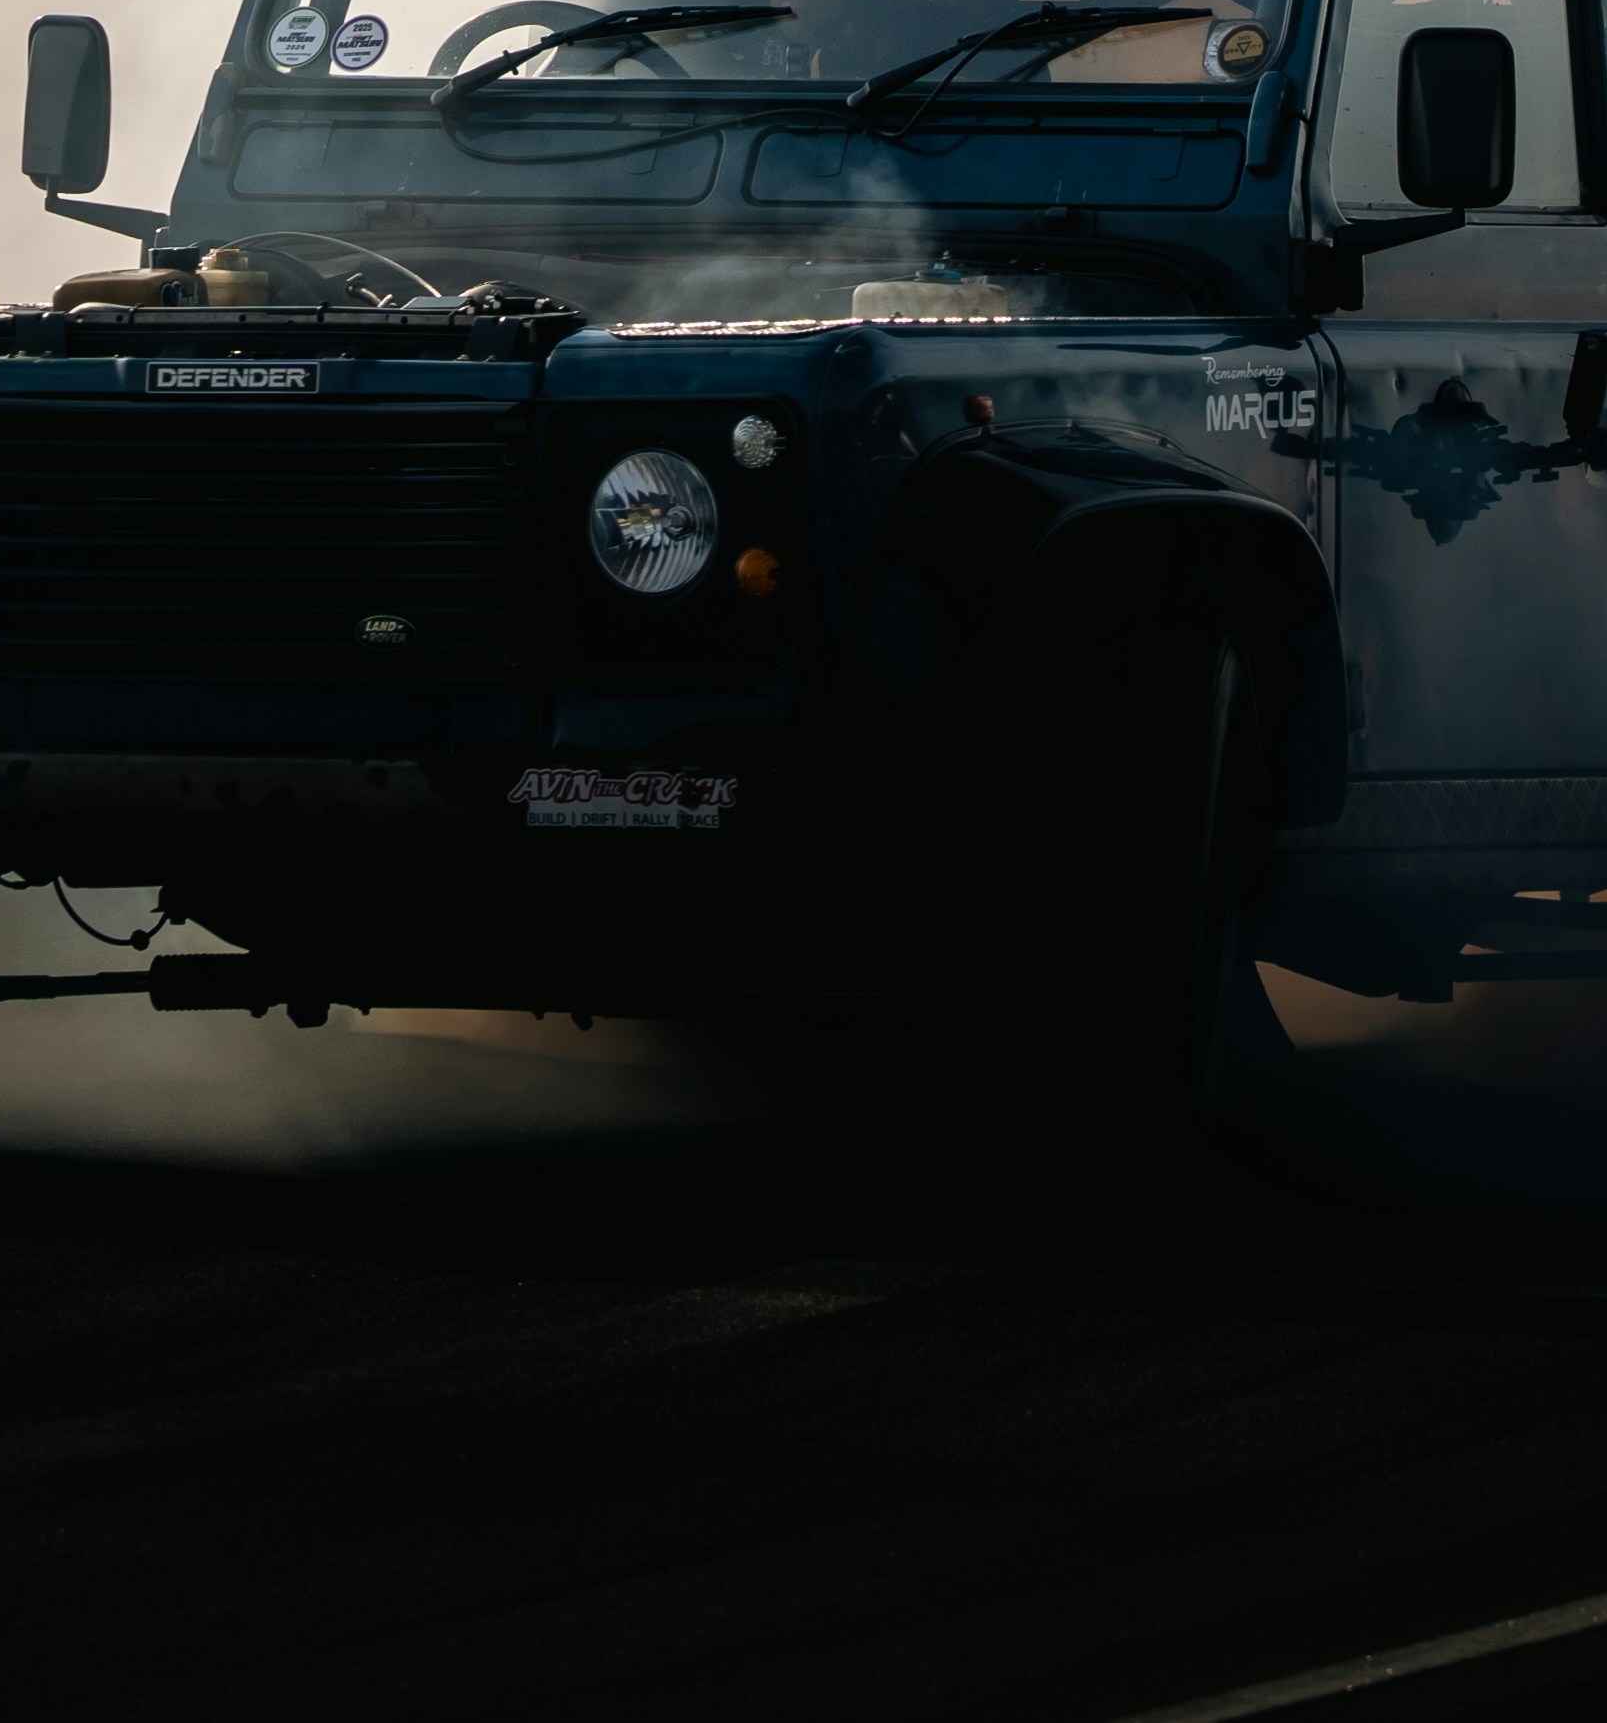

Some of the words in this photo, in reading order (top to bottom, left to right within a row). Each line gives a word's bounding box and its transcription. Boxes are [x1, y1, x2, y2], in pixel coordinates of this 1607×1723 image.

[156, 367, 310, 388] DEFENDER
[1200, 355, 1286, 387] Remembering
[1205, 389, 1316, 439] MARCUS
[509, 769, 598, 803] AVIN
[594, 780, 623, 797] THE
[527, 812, 567, 825] BUILD
[581, 812, 618, 825] DRIFT
[632, 813, 671, 826] RALLY
